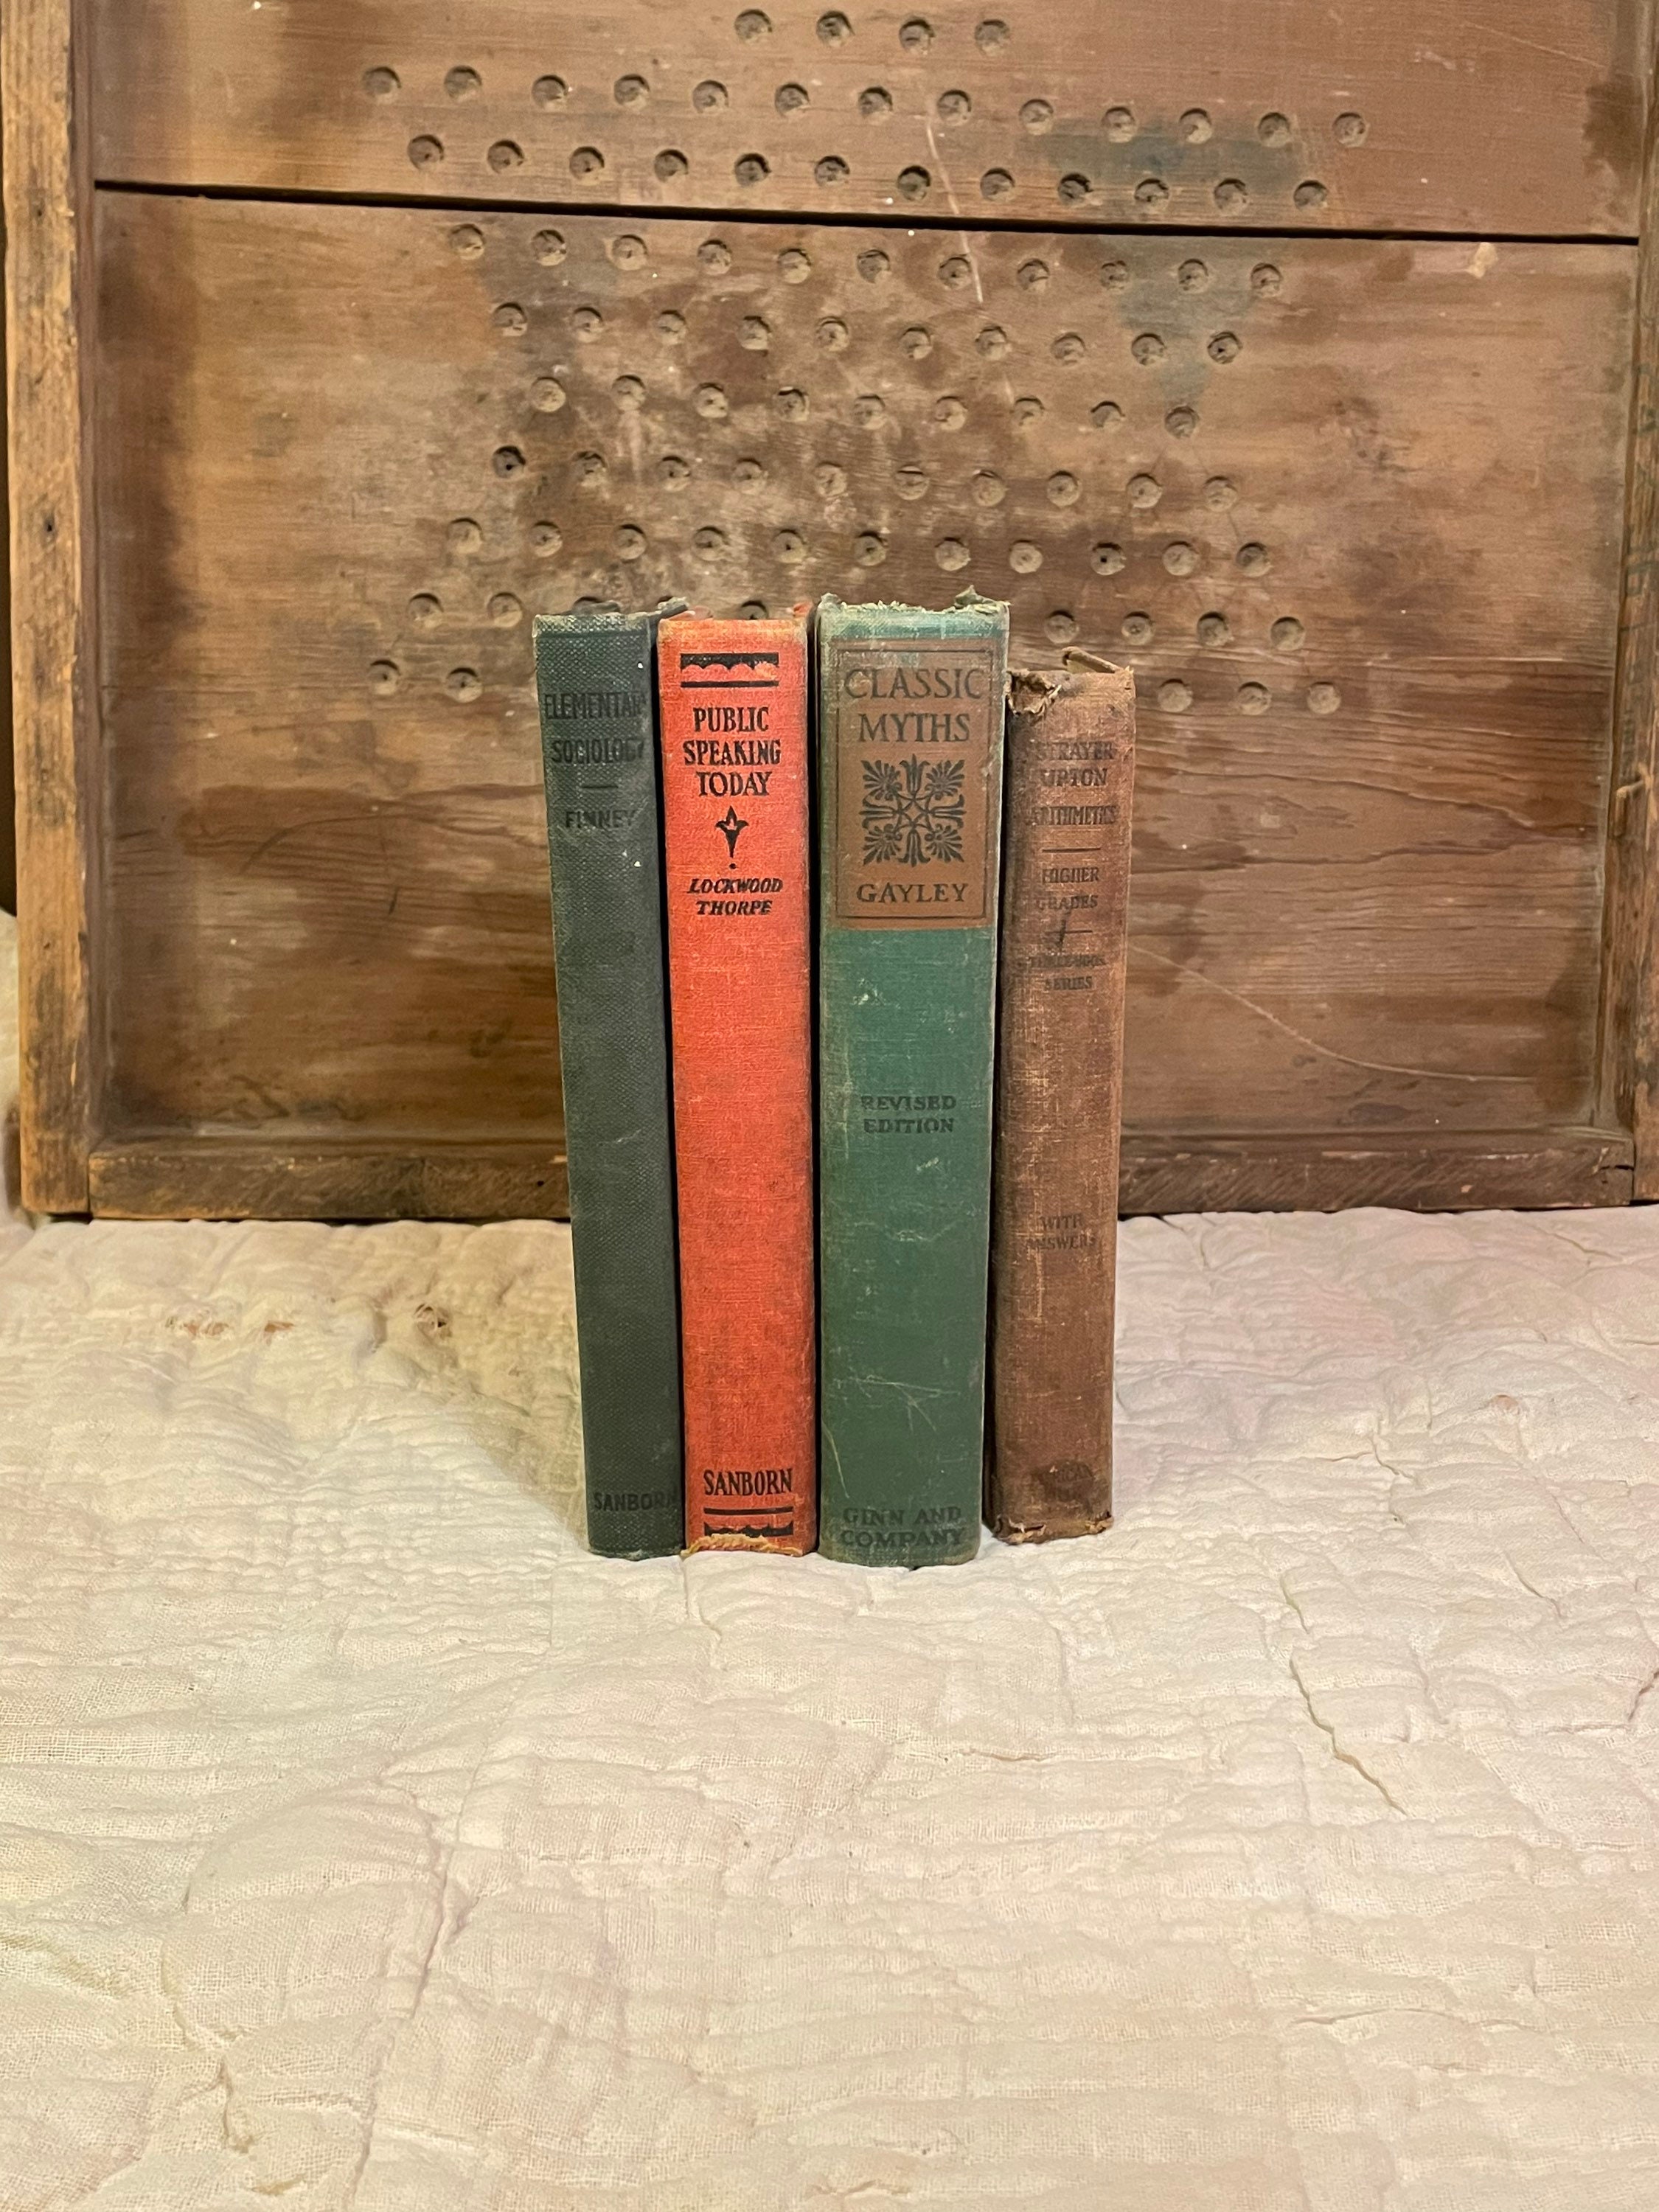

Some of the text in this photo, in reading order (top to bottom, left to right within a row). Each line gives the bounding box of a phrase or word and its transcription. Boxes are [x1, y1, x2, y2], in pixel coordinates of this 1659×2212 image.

[845, 668, 982, 699] CLASSIC
[692, 706, 769, 732] PUBLIC
[858, 712, 970, 742] MYTHS
[682, 740, 781, 766] SPEAKING
[695, 771, 773, 796] TODAY
[687, 878, 783, 894] LOCKWOOD
[856, 883, 969, 902] GAYLEY
[696, 901, 773, 915] THORPE
[860, 1096, 956, 1111] REVISED
[863, 1118, 954, 1133] EDITION
[703, 1468, 793, 1496] SANBORN
[843, 1506, 962, 1524] GINN AND
[840, 1529, 964, 1548] COMPANY
